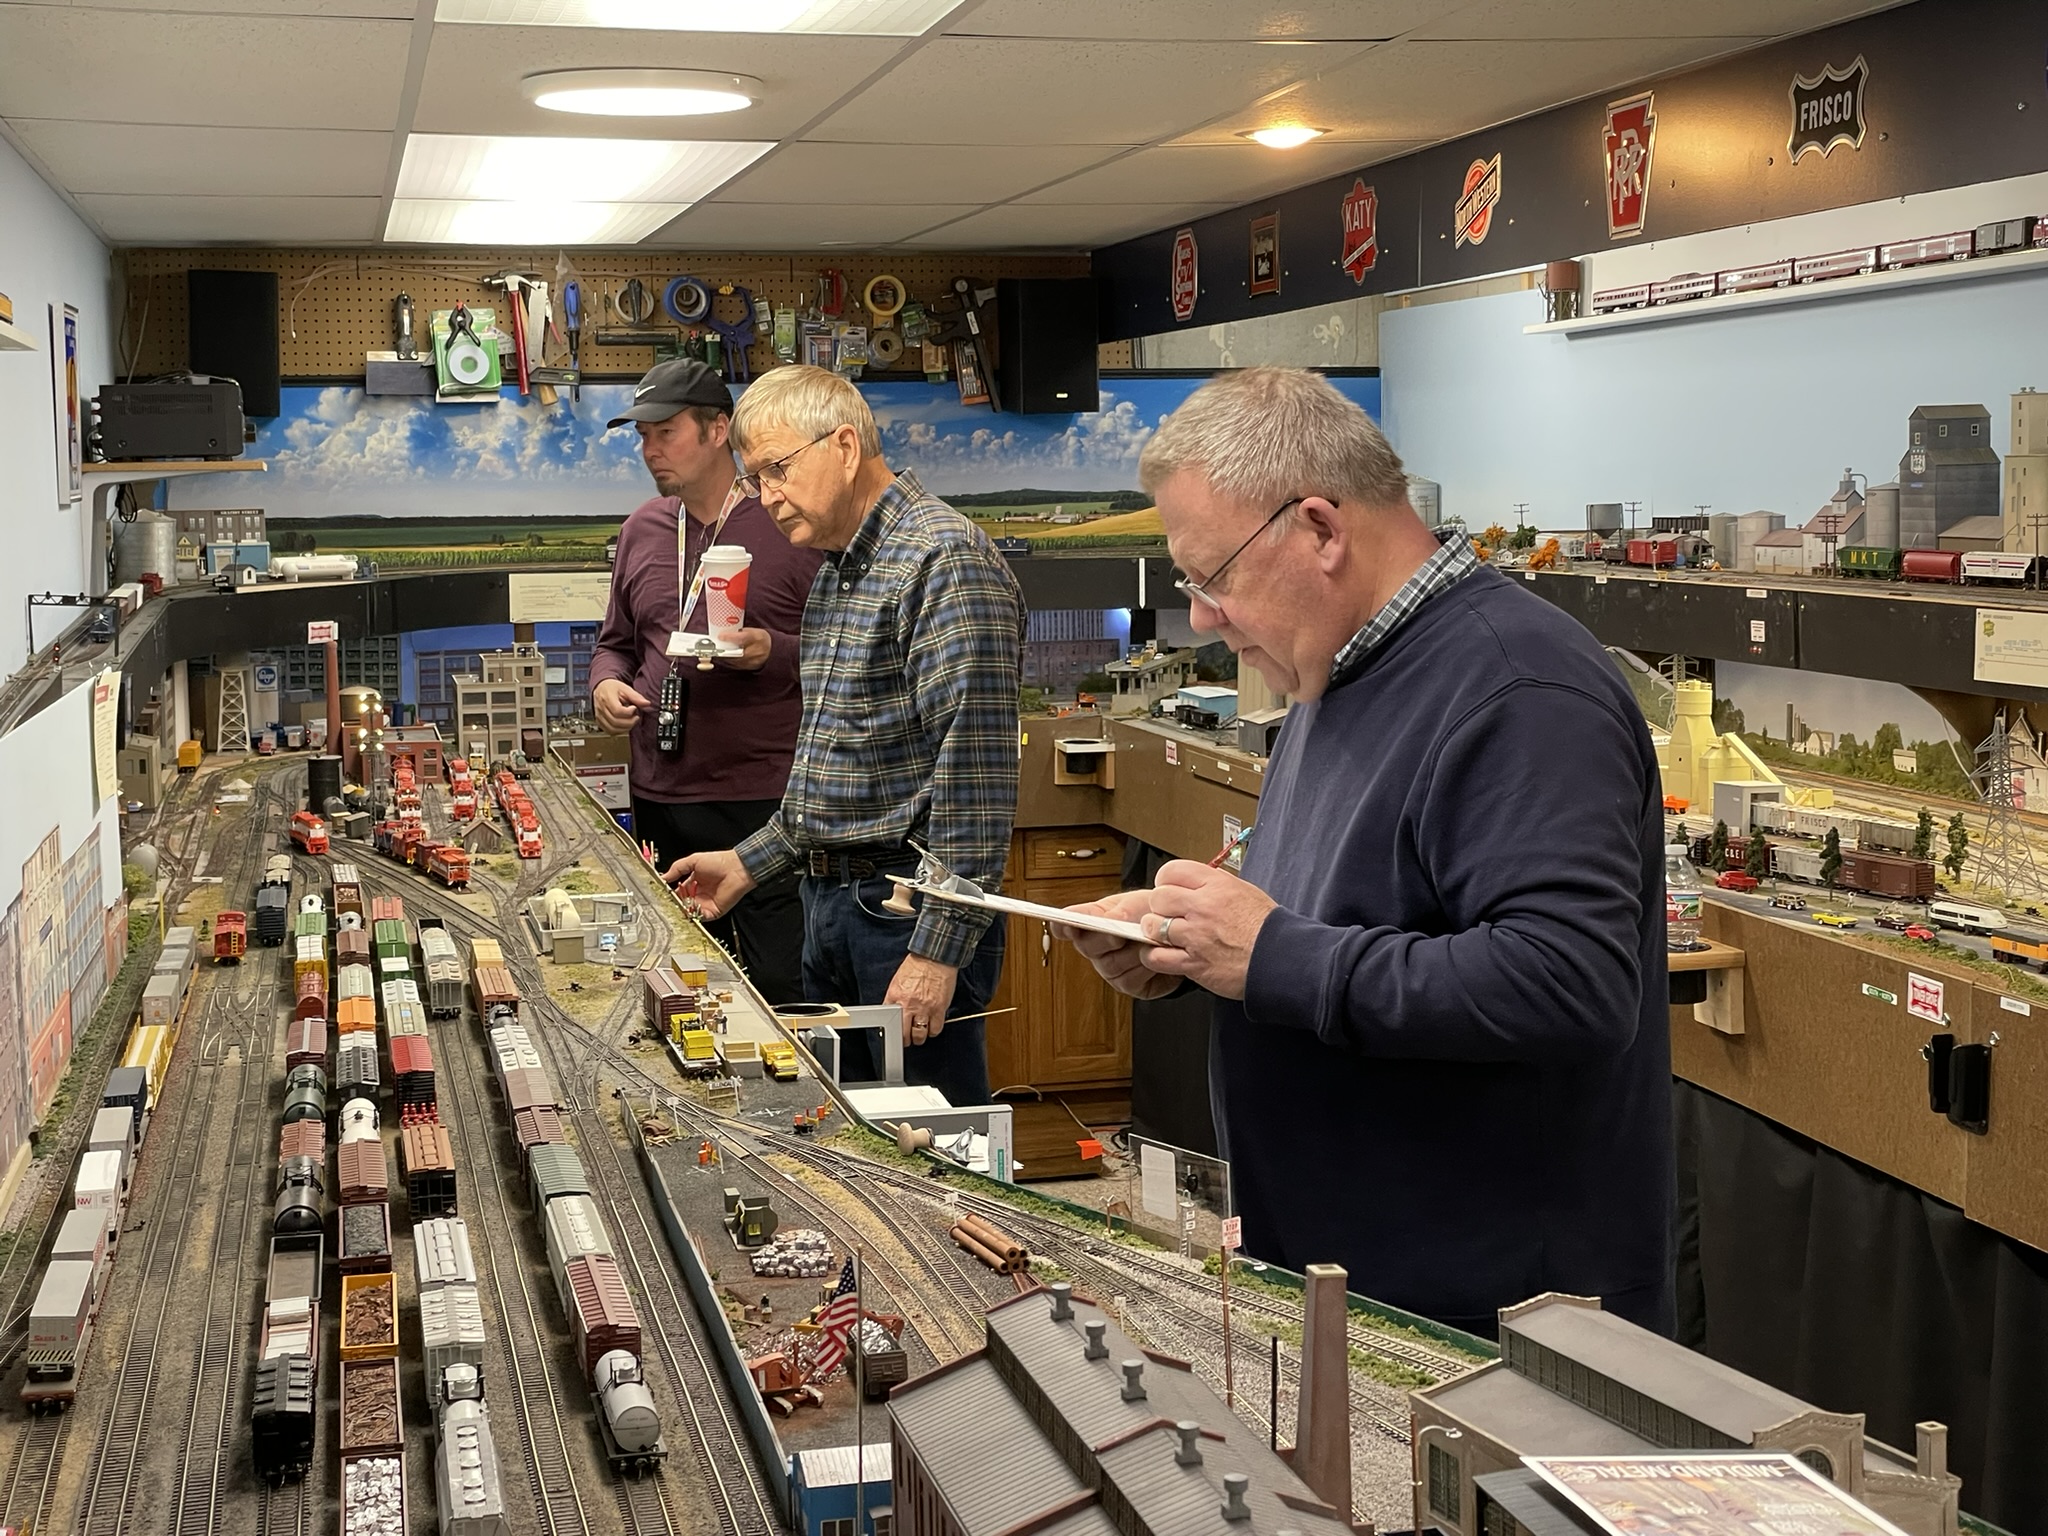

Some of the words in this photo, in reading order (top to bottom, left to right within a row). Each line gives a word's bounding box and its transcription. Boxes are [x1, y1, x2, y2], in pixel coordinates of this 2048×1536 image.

[1800, 90, 1852, 132] FRISCO
[1345, 198, 1372, 233] KATY
[1801, 816, 1827, 828] FRISCO
[77, 1197, 92, 1205] NW
[1577, 1463, 1668, 1478] METALS
[1669, 1463, 1784, 1478] MIDLAND
